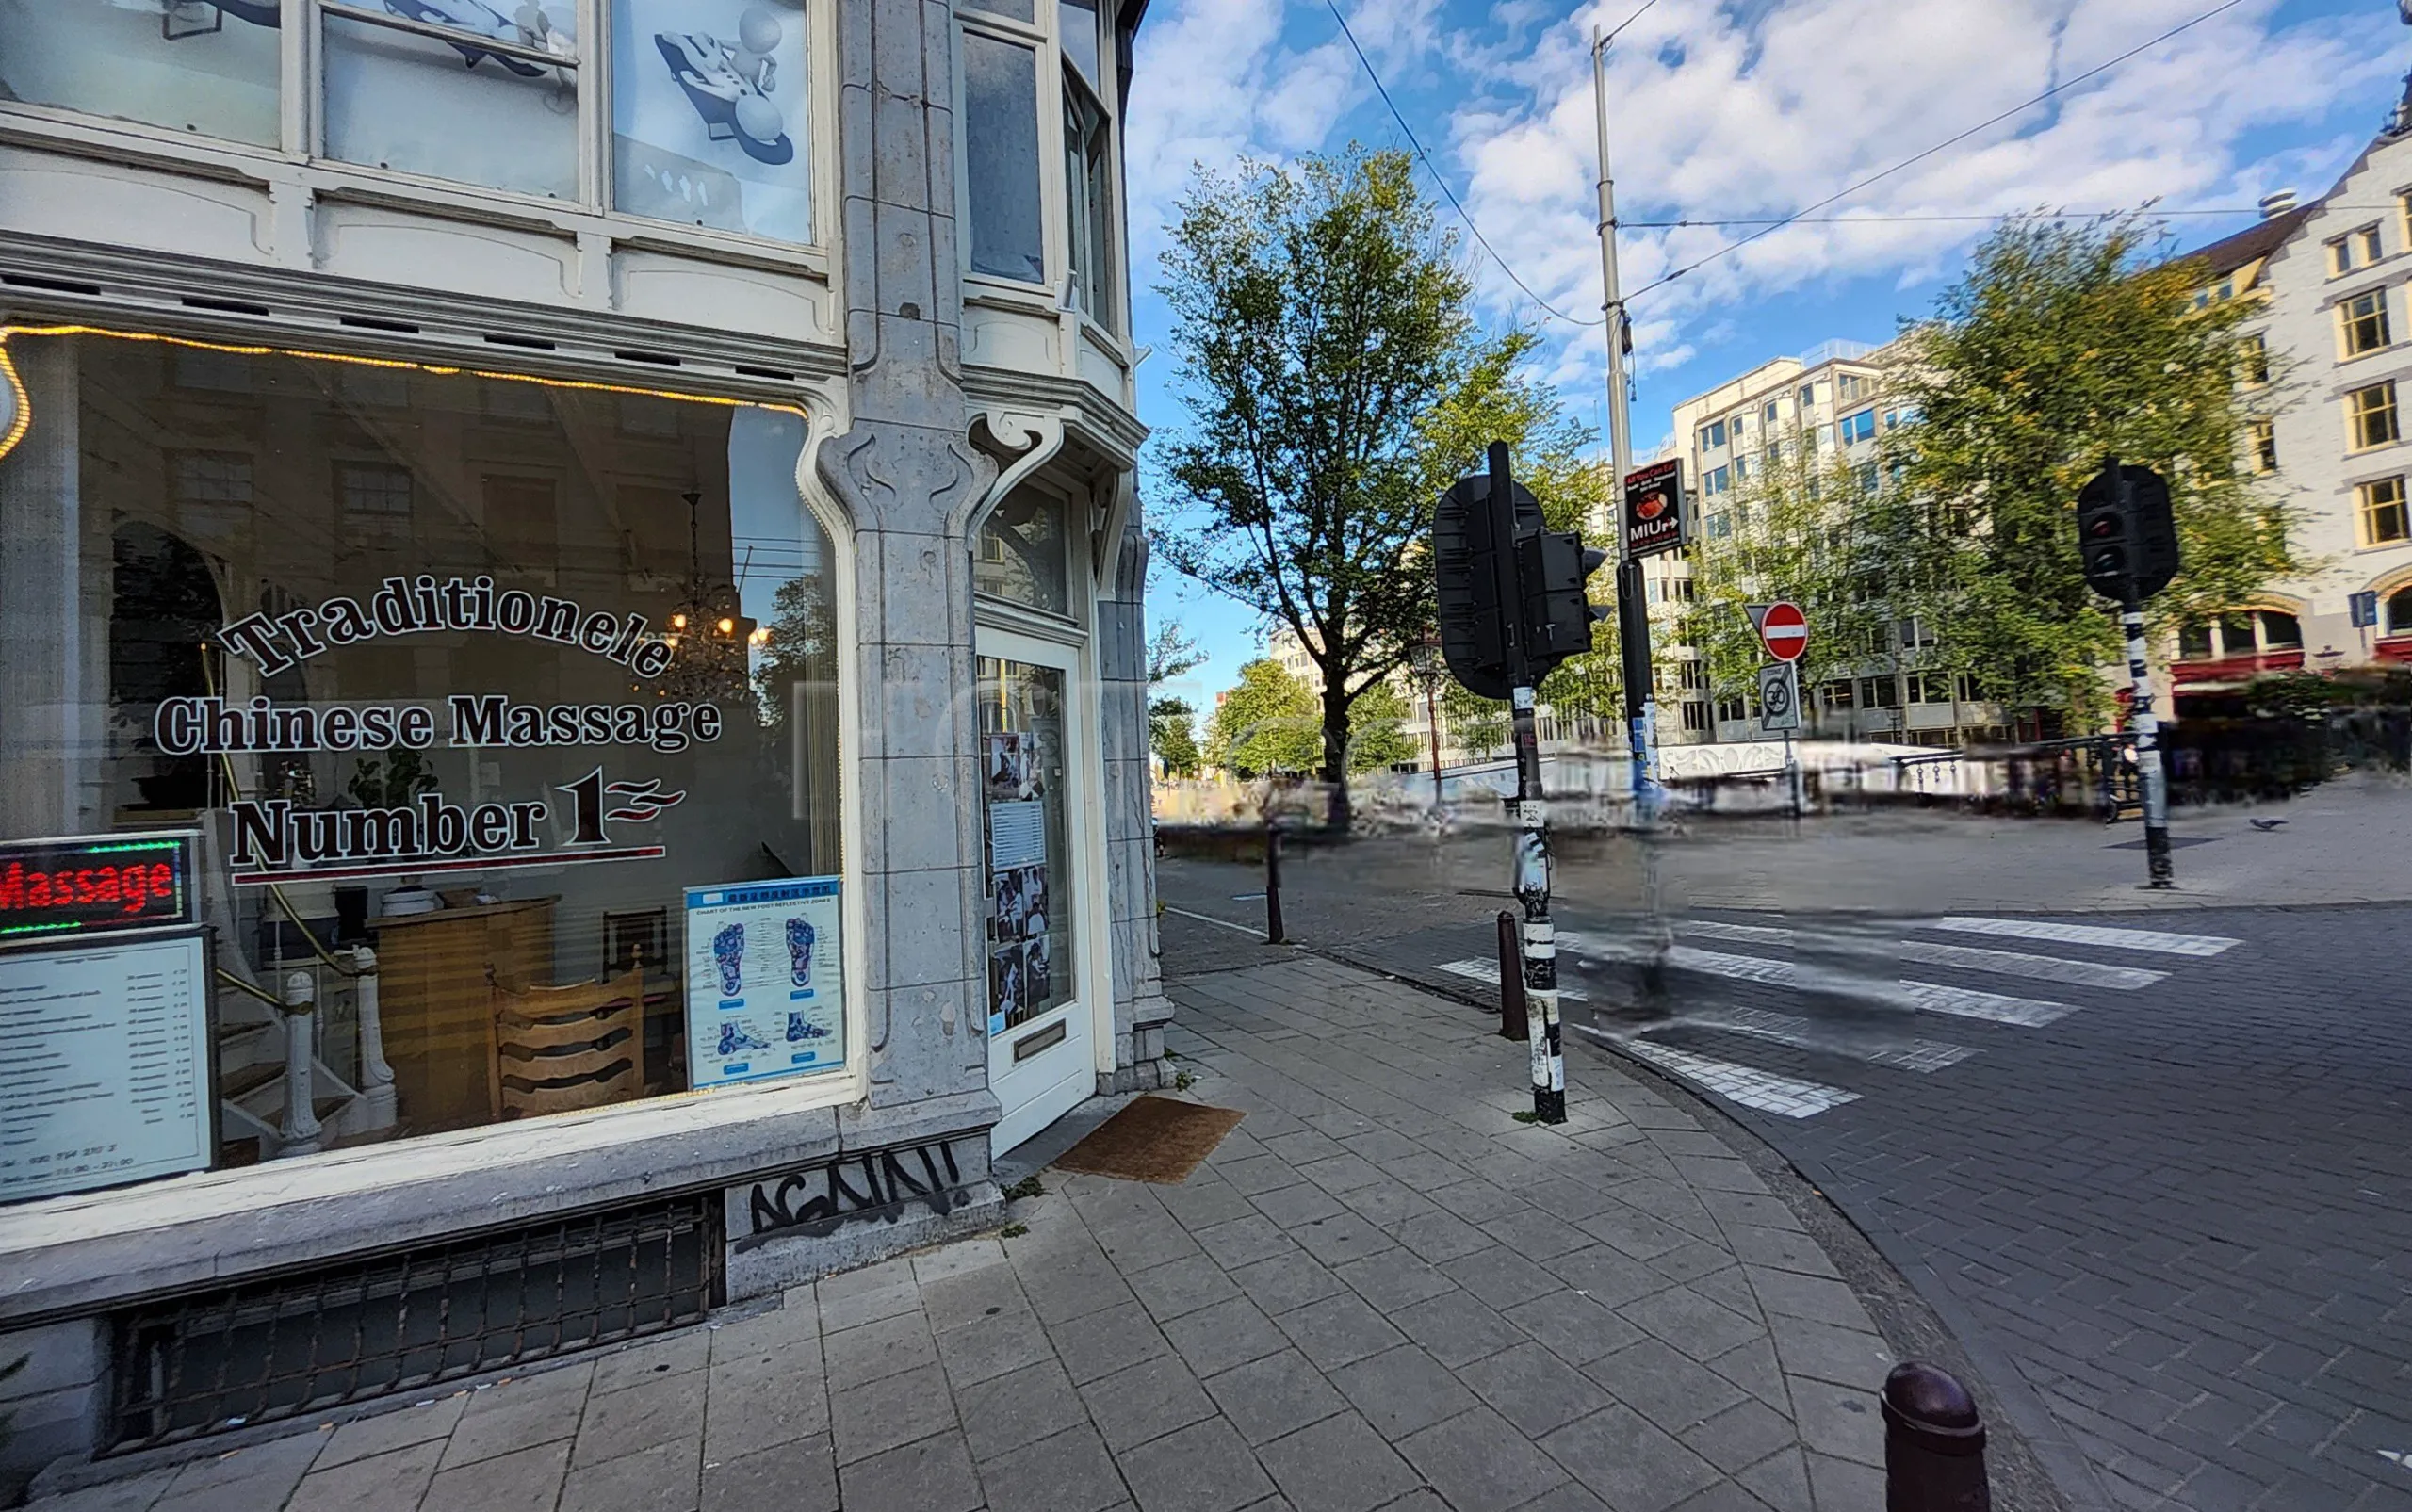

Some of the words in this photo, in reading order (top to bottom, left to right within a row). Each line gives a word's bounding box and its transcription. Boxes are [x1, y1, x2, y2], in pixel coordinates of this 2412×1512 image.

[219, 574, 676, 678] Traditionele
[154, 695, 434, 755] Chinese
[448, 694, 722, 754] Massage
[1768, 690, 1785, 706] 30
[230, 792, 549, 868] Number
[556, 765, 611, 847] 1
